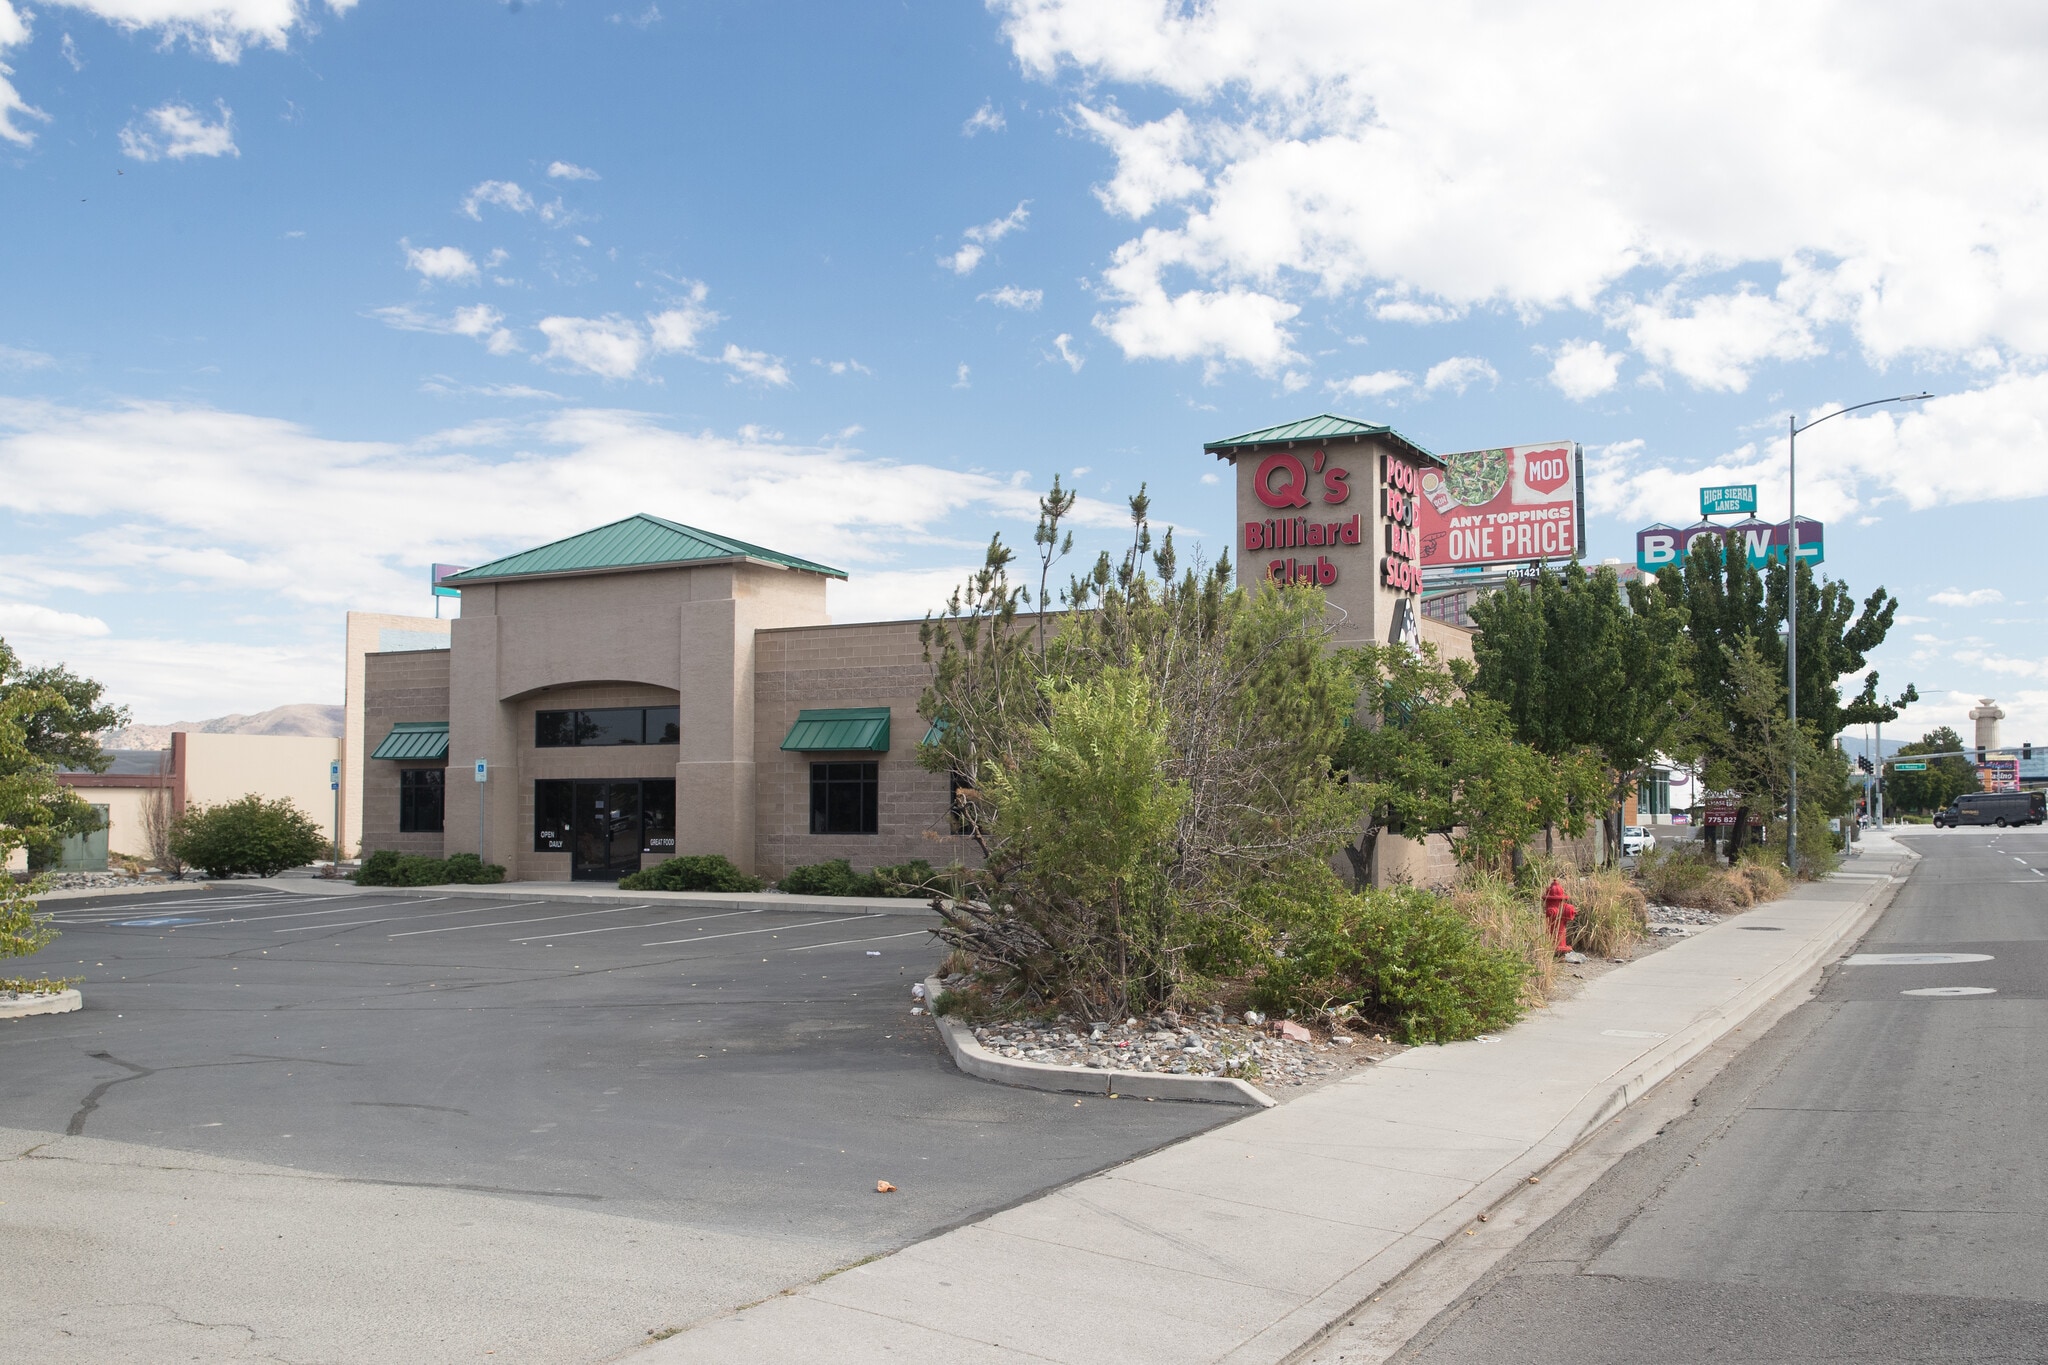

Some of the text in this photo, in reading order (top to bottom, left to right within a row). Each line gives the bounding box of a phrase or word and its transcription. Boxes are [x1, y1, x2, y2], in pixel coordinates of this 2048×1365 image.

[1254, 450, 1349, 508] Q's
[1385, 455, 1420, 497] POOL
[1529, 458, 1564, 482] MOD
[1385, 487, 1420, 528] FOOD
[1703, 487, 1754, 506] HIGH SIERRA
[1715, 500, 1740, 511] LANES
[1244, 514, 1361, 550] Billiard
[1450, 507, 1571, 529] ANY TOPPINGS
[1391, 524, 1417, 561] BAR
[1450, 520, 1571, 560] ONE PRICE
[1265, 555, 1337, 588] Club
[1385, 556, 1423, 595] SLOTS
[549, 840, 563, 848] DAILY
[650, 838, 675, 846] GREAT FOOD
